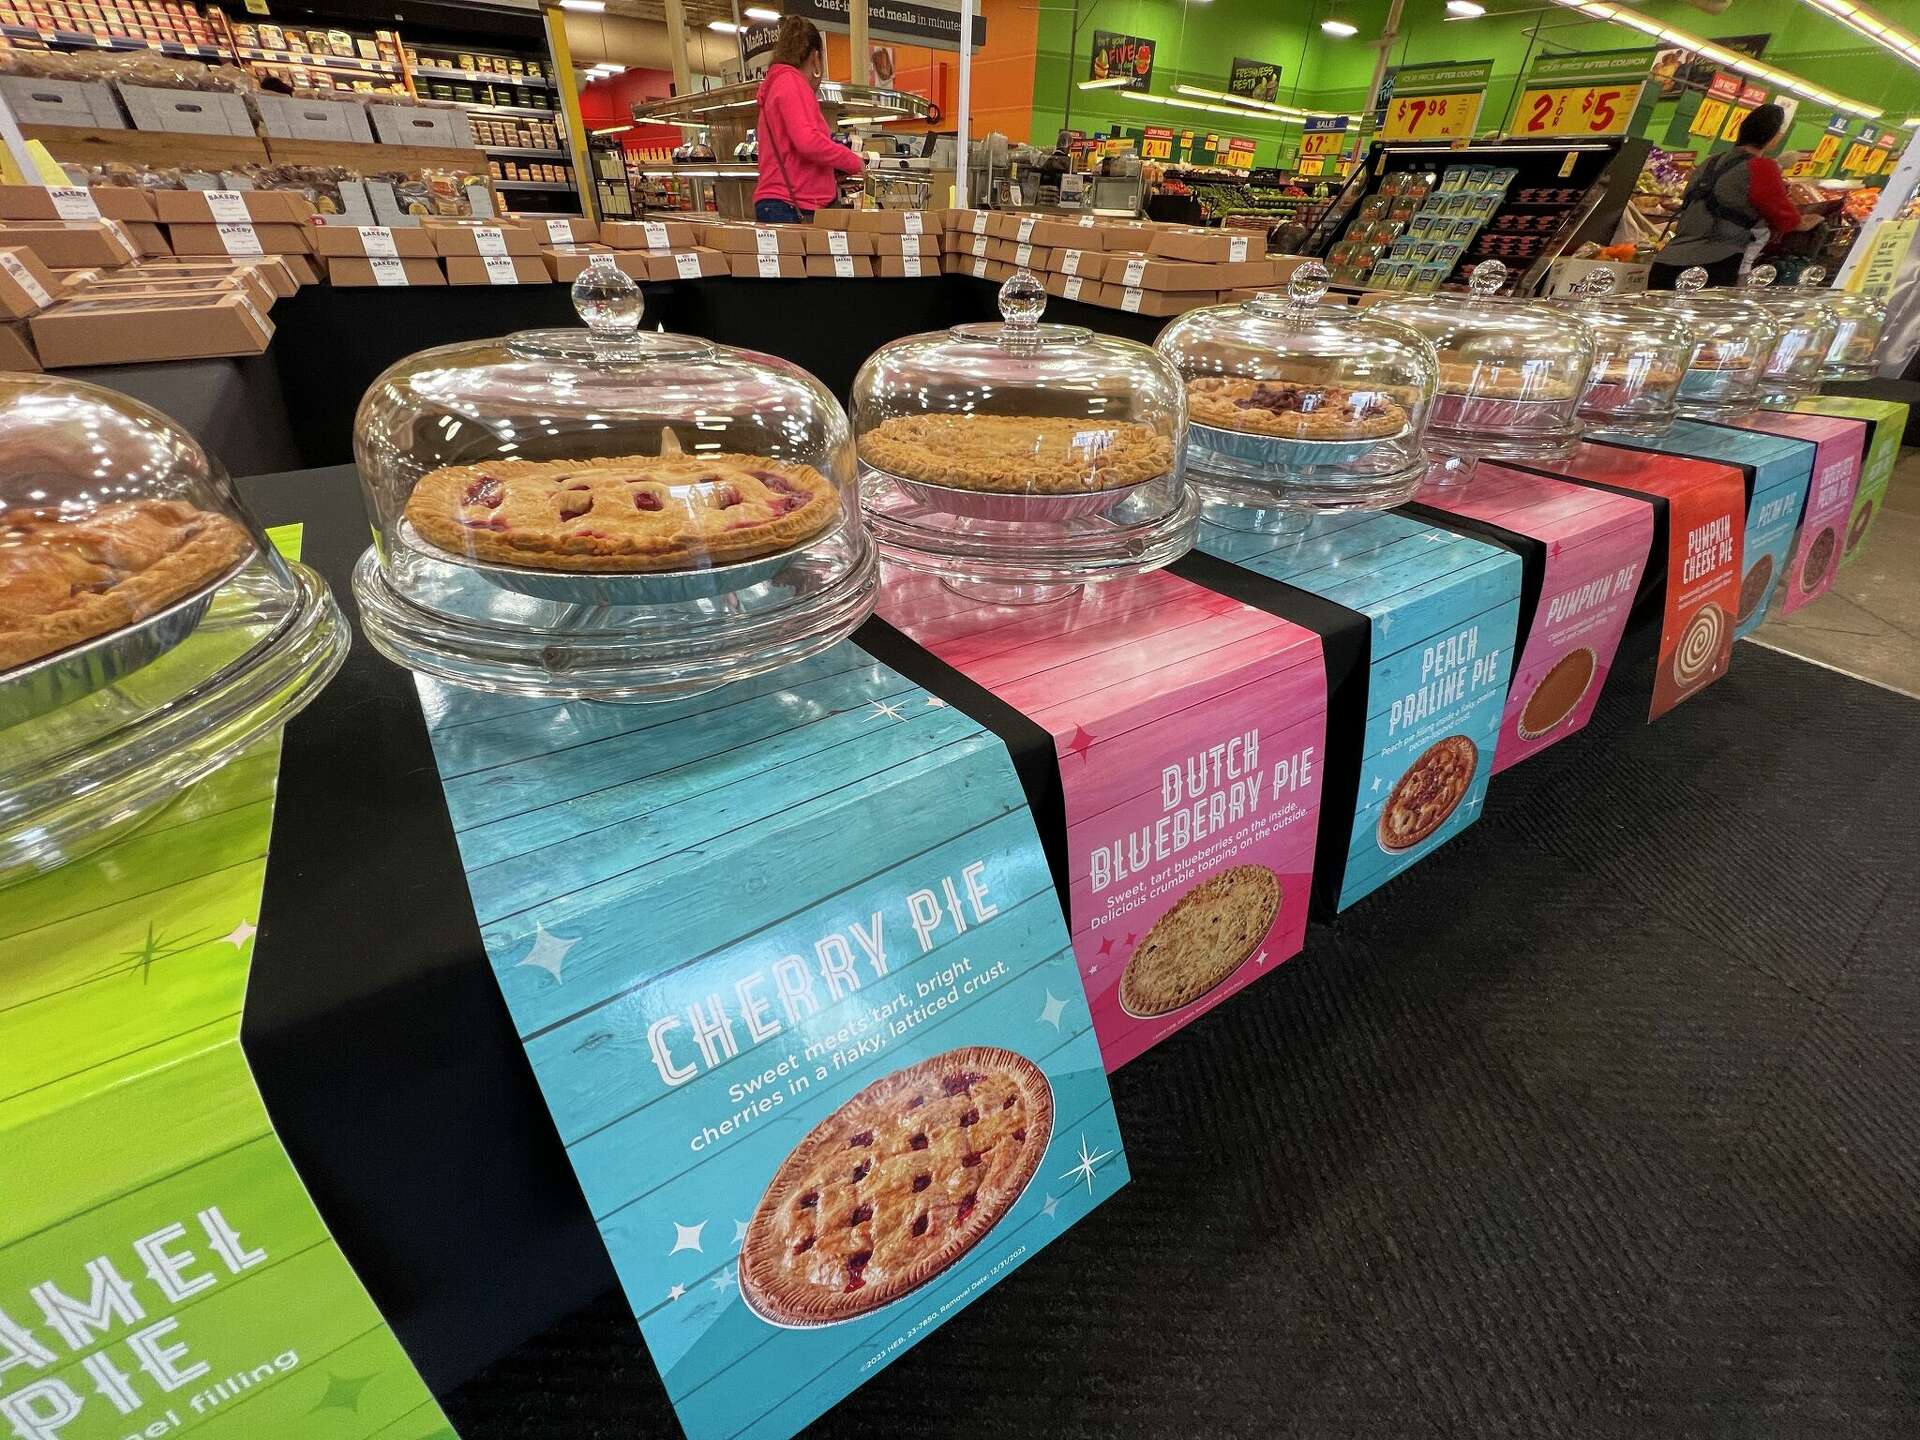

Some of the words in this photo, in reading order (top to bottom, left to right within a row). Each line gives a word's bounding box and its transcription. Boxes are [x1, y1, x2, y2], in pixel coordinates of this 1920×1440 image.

[887, 10, 916, 24] meals
[917, 14, 926, 25] in
[1527, 94, 1554, 132] 2
[1582, 89, 1621, 131] $5
[52, 190, 88, 198] BAKERY
[1683, 544, 1717, 584] CHEESE
[1719, 537, 1733, 566] PIE
[1688, 514, 1730, 557] PUMPKIN
[1545, 574, 1613, 627] PUMPKIN
[1612, 563, 1638, 597] PIE
[1422, 626, 1478, 684] PEACH
[1389, 665, 1467, 736] PRALINE
[1471, 649, 1499, 691] PIE
[1161, 728, 1260, 812] DUTCH
[1090, 770, 1263, 893] BLUEBERRY
[1273, 746, 1314, 801] PIE
[1151, 867, 1171, 886] tart
[1174, 834, 1233, 875] blueberries
[1236, 827, 1249, 841] on
[1251, 818, 1266, 834] the
[1268, 801, 1299, 823] inside.
[1091, 894, 1148, 931] Delicious
[1149, 867, 1195, 899] crumble
[1197, 847, 1238, 873] topping
[1240, 837, 1253, 850] on
[1255, 826, 1271, 842] the
[1272, 808, 1309, 832] outside.
[647, 910, 890, 1087] CHERRY
[905, 860, 999, 953] PIE
[690, 1092, 785, 1151] cherries
[788, 1074, 810, 1096] in
[815, 1067, 828, 1081] a
[832, 1033, 886, 1071] flaky,
[890, 986, 960, 1036] latticed
[963, 959, 1010, 994] crust.
[728, 1053, 800, 1104] Sweet
[804, 1016, 868, 1062] meets
[917, 956, 972, 998] bright
[940, 1288, 971, 1313] Removal
[190, 1350, 299, 1414] filling
